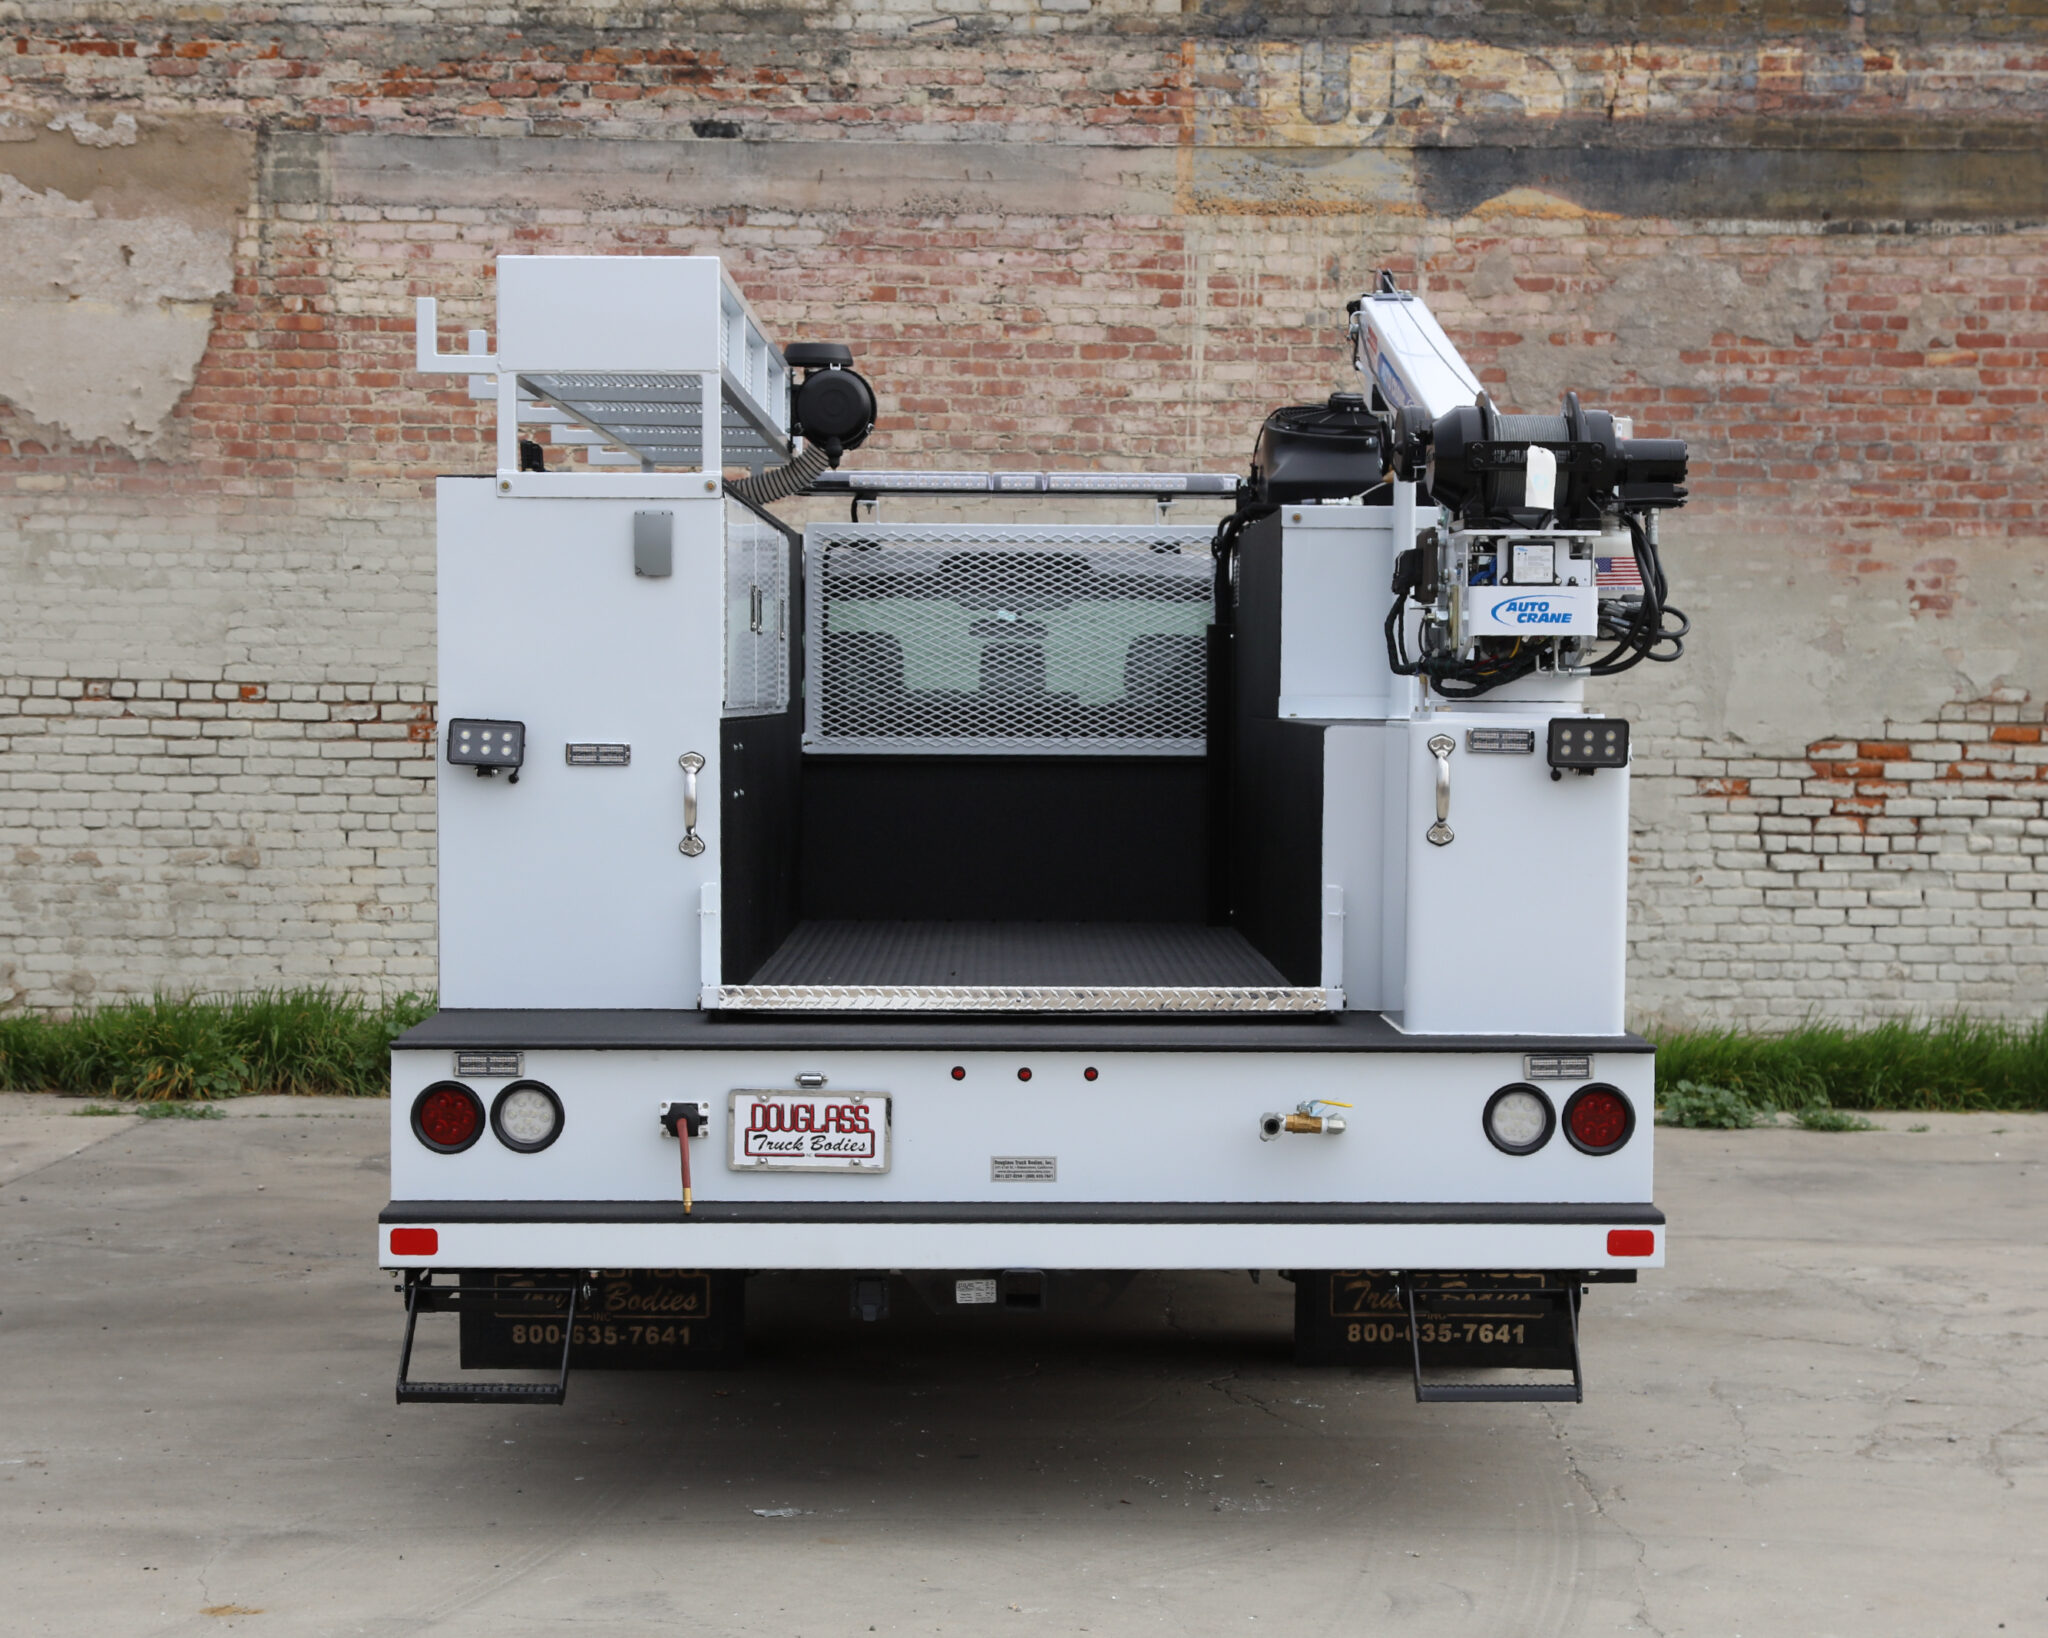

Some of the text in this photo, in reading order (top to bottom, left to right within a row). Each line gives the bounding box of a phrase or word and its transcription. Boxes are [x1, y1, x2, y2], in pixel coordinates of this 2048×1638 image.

[1506, 602, 1550, 612] AUTO
[1517, 613, 1573, 623] CRANE
[751, 1103, 870, 1133] DOUGLASS
[752, 1134, 867, 1151] Truck Bodies
[605, 1281, 698, 1311] Bodies
[512, 1324, 690, 1345] 800-635-7641
